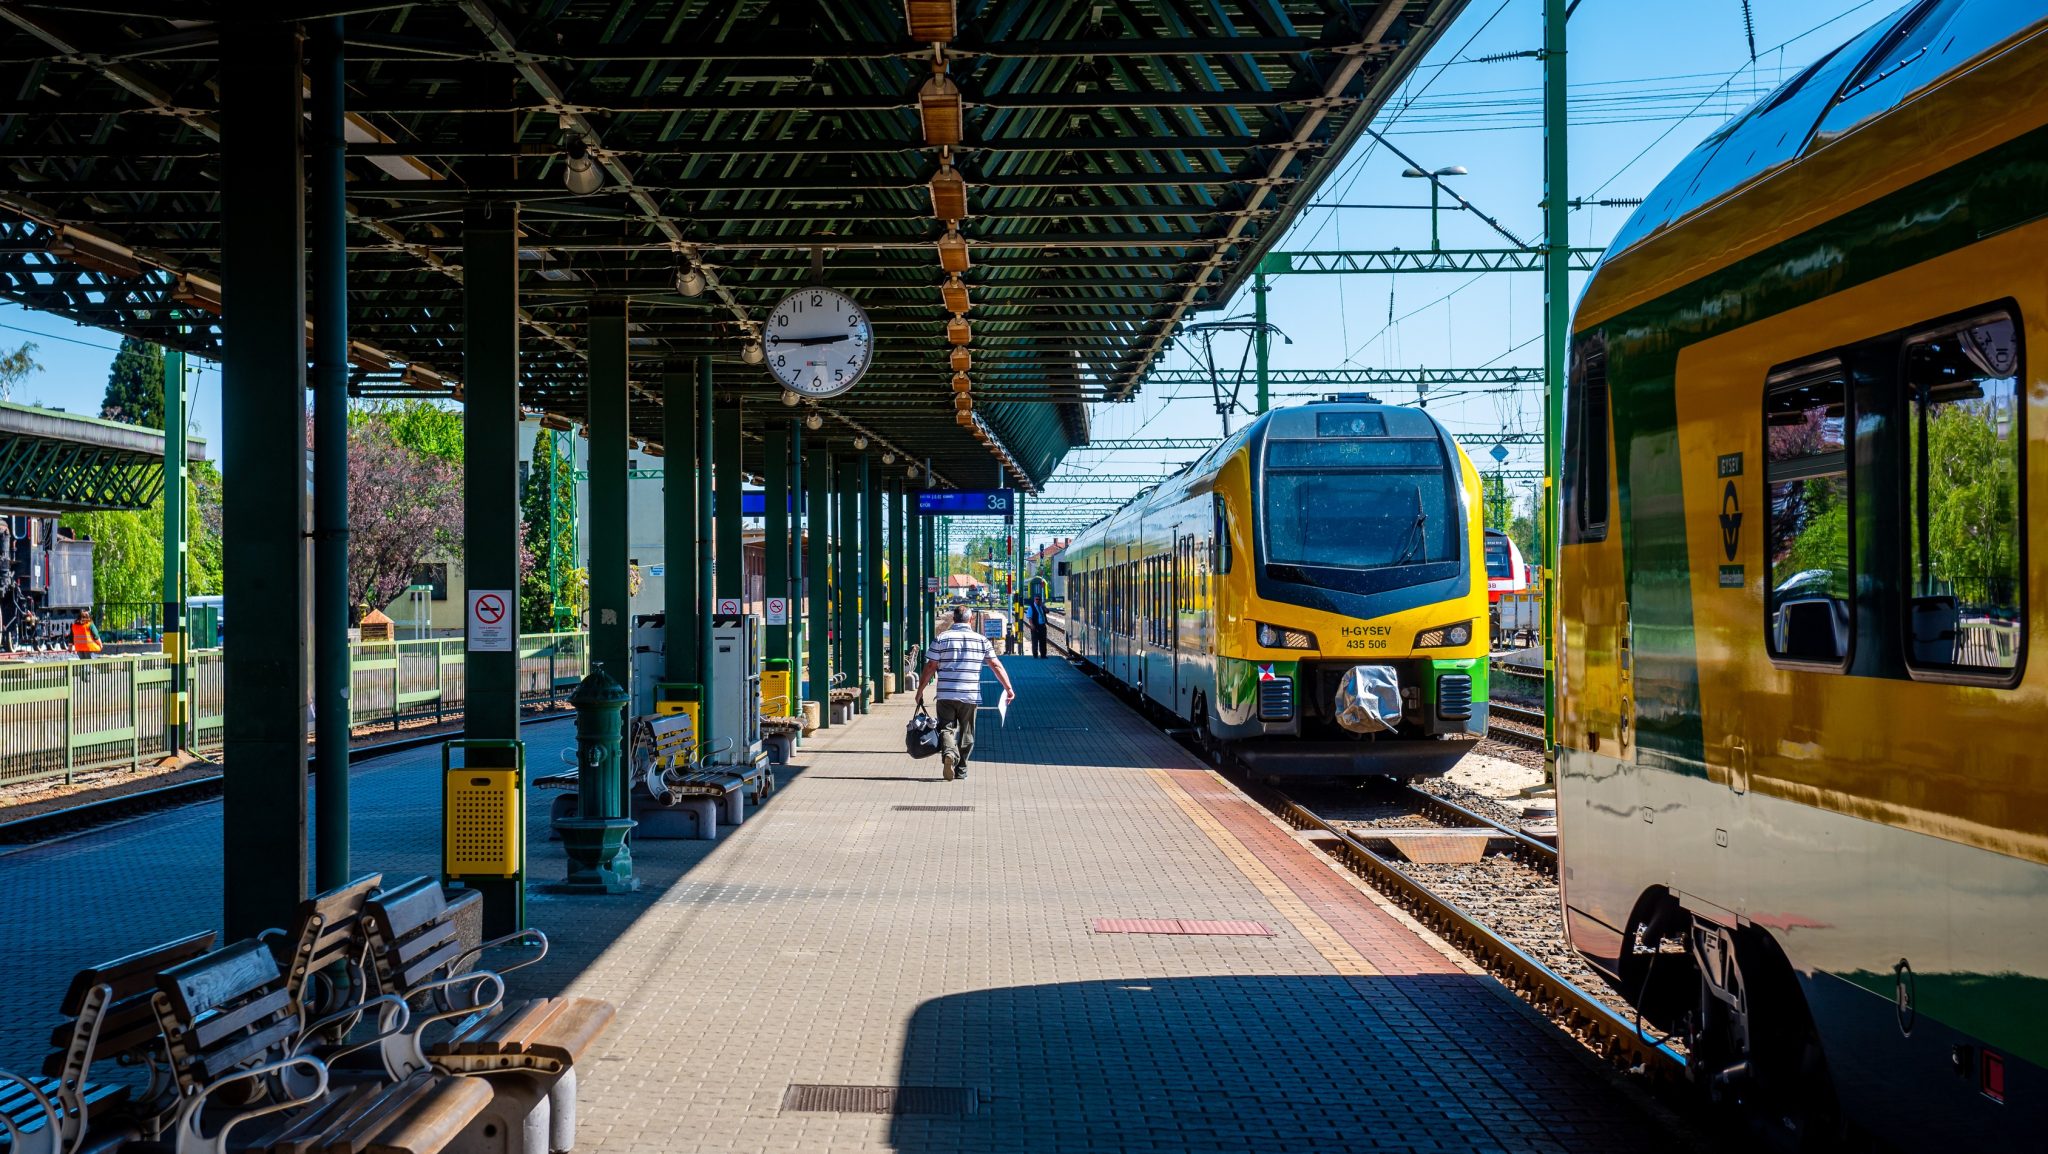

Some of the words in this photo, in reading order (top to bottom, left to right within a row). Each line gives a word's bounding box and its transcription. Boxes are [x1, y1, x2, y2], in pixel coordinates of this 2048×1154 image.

[811, 294, 822, 307] 12
[793, 301, 802, 312] 11
[778, 315, 788, 327] 10
[848, 315, 858, 327] 2
[771, 335, 780, 347] 9
[855, 335, 862, 346] 3
[777, 355, 785, 367] 8
[847, 355, 857, 367] 4
[793, 370, 801, 381] 7
[835, 370, 843, 381] 5
[813, 376, 821, 387] 6
[988, 494, 1006, 510] 3a
[1342, 626, 1392, 636] H-GYSEV
[1346, 640, 1365, 648] 435
[1368, 640, 1386, 648] 506
